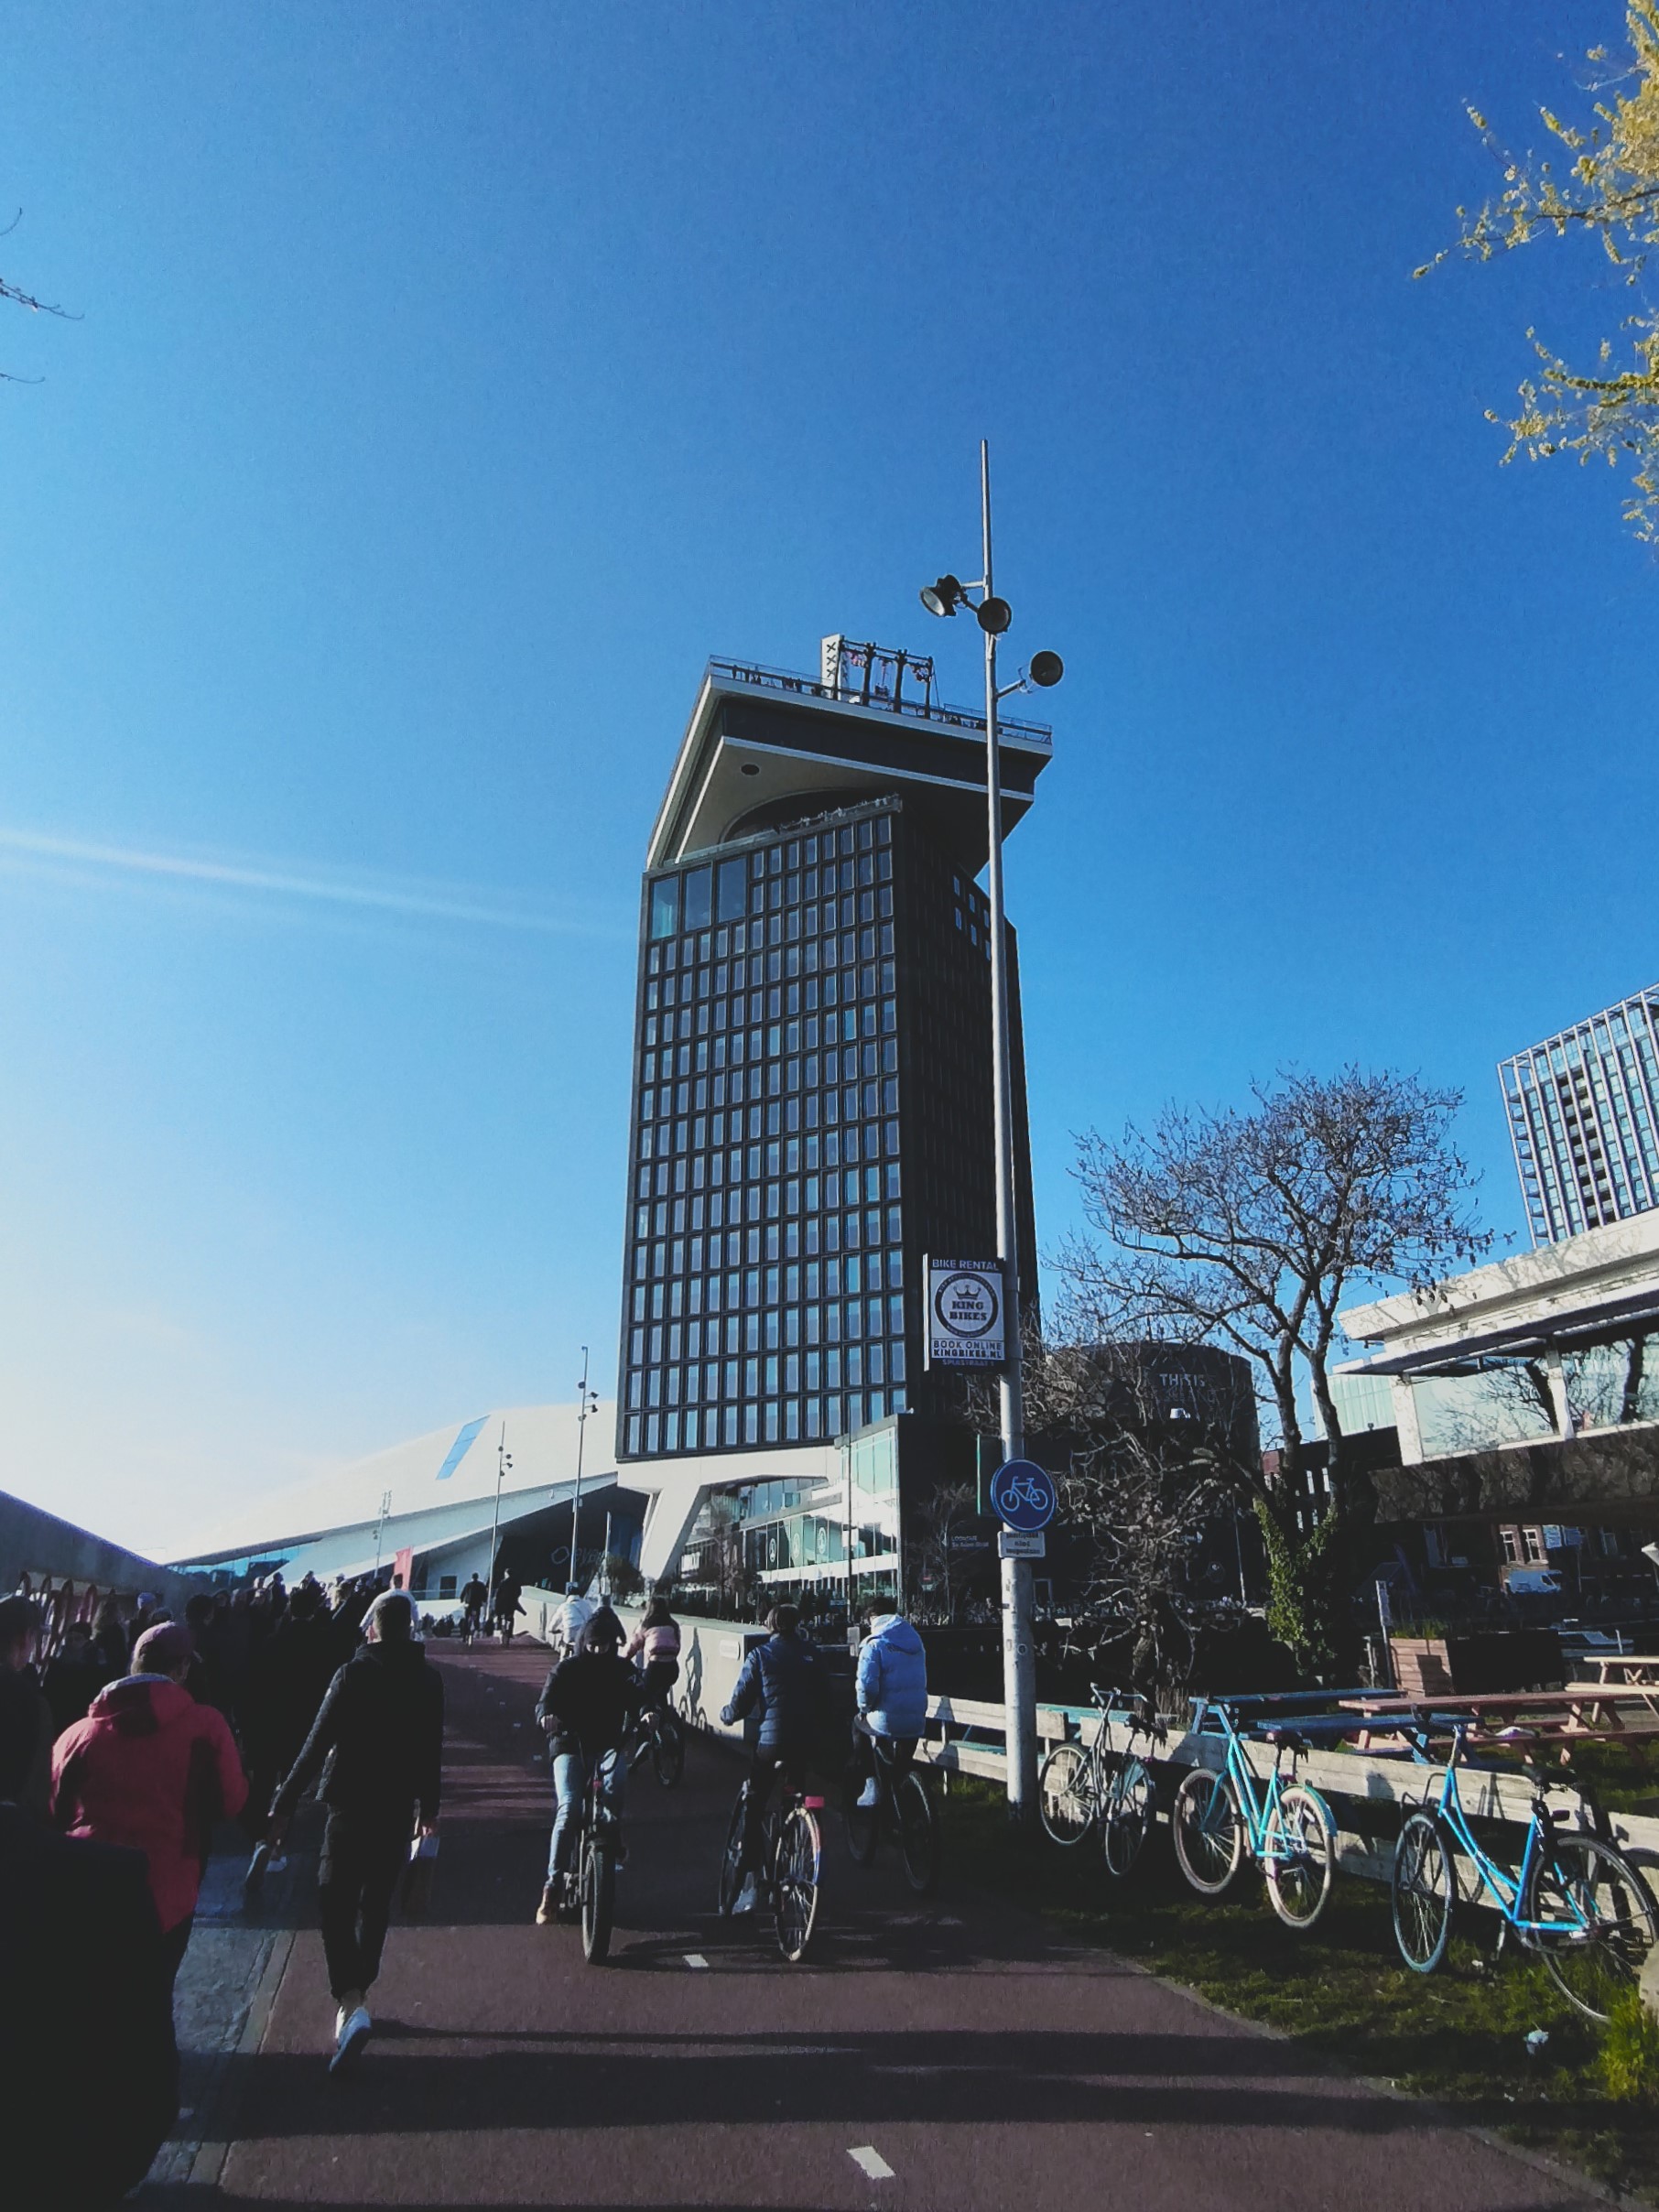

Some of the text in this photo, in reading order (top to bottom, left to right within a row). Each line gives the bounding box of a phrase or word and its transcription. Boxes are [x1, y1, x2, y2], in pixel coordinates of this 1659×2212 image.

[932, 1259, 999, 1271] BIKE RENTAL
[952, 1301, 984, 1310] KING
[949, 1311, 988, 1321] BIKES
[934, 1340, 1002, 1350] BOOK ONLINE
[934, 1349, 1002, 1359] KINGBIKES.NL
